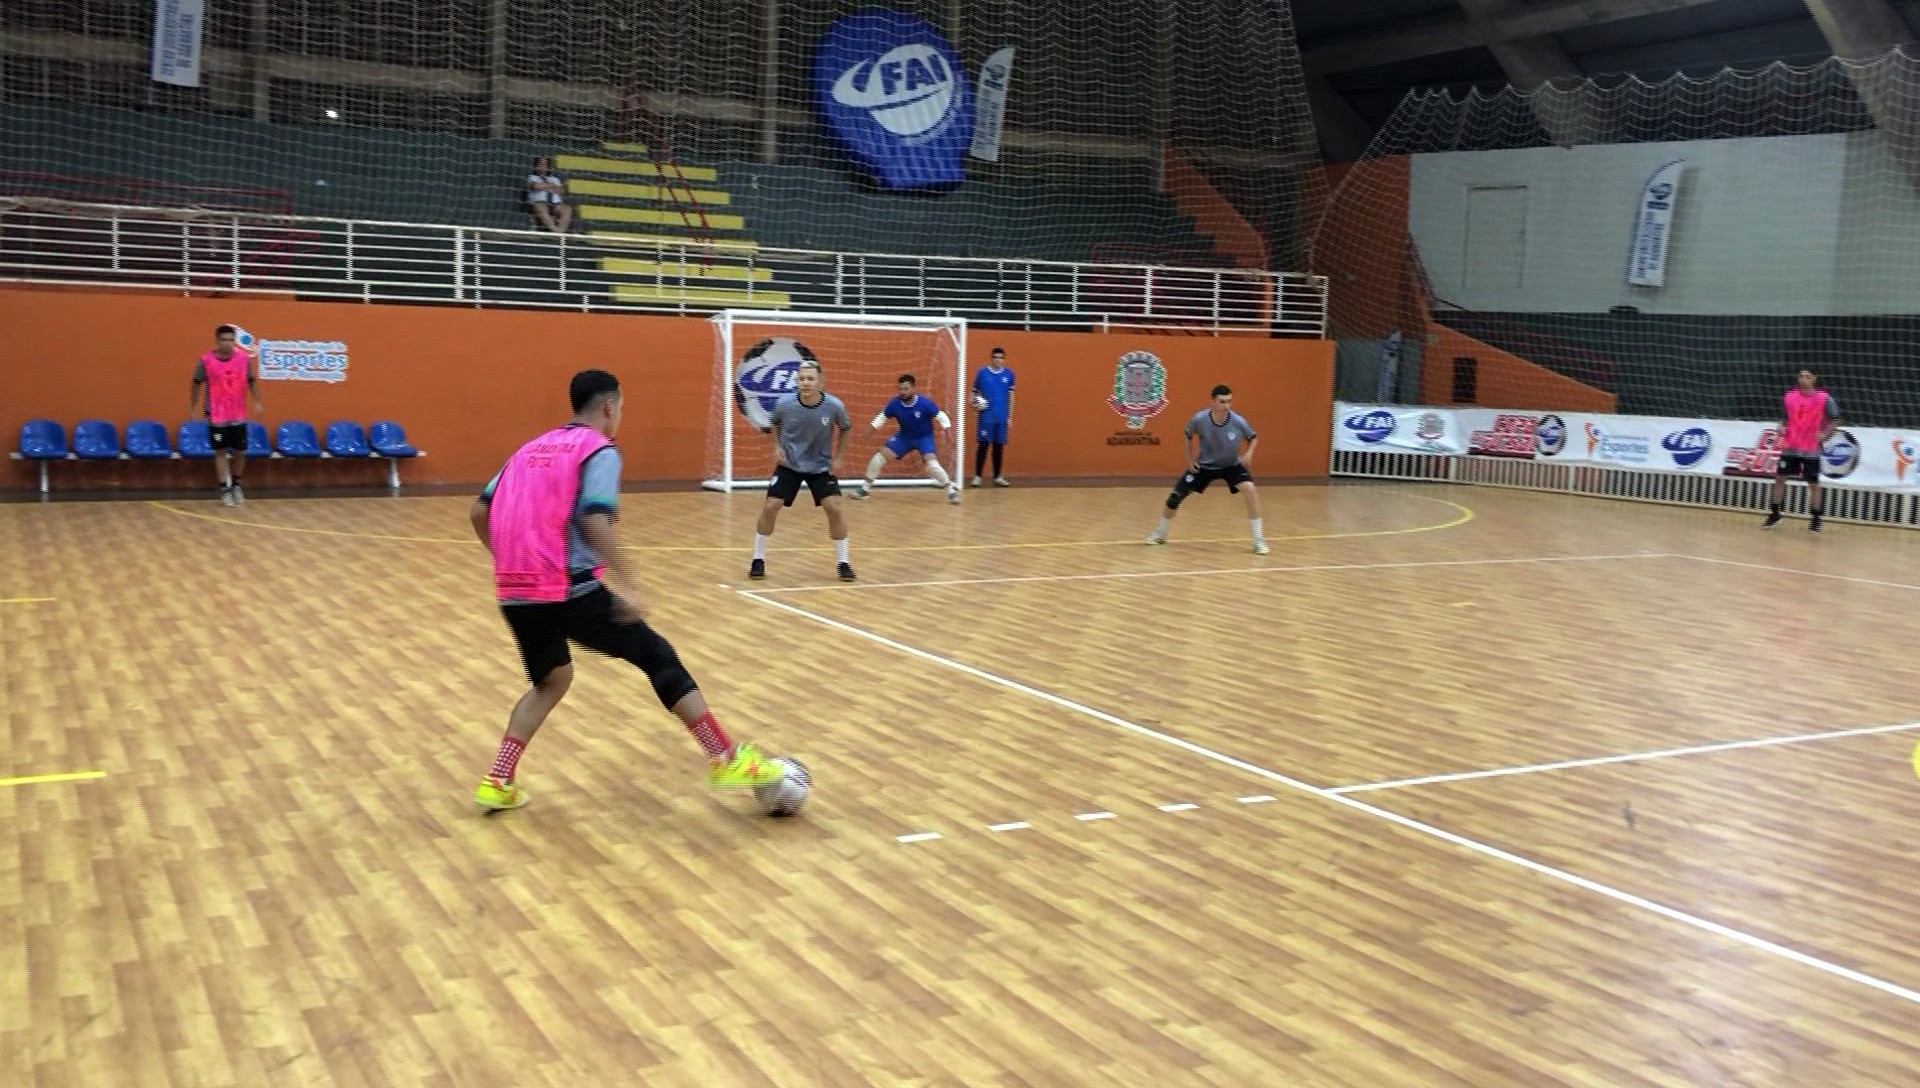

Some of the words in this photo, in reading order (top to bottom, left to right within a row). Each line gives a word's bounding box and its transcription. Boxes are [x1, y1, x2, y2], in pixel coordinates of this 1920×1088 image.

[879, 53, 948, 96] FAI
[260, 348, 347, 371] Esportes
[770, 369, 798, 390] FA
[1364, 416, 1396, 429] FAI
[1680, 433, 1710, 448] FAI
